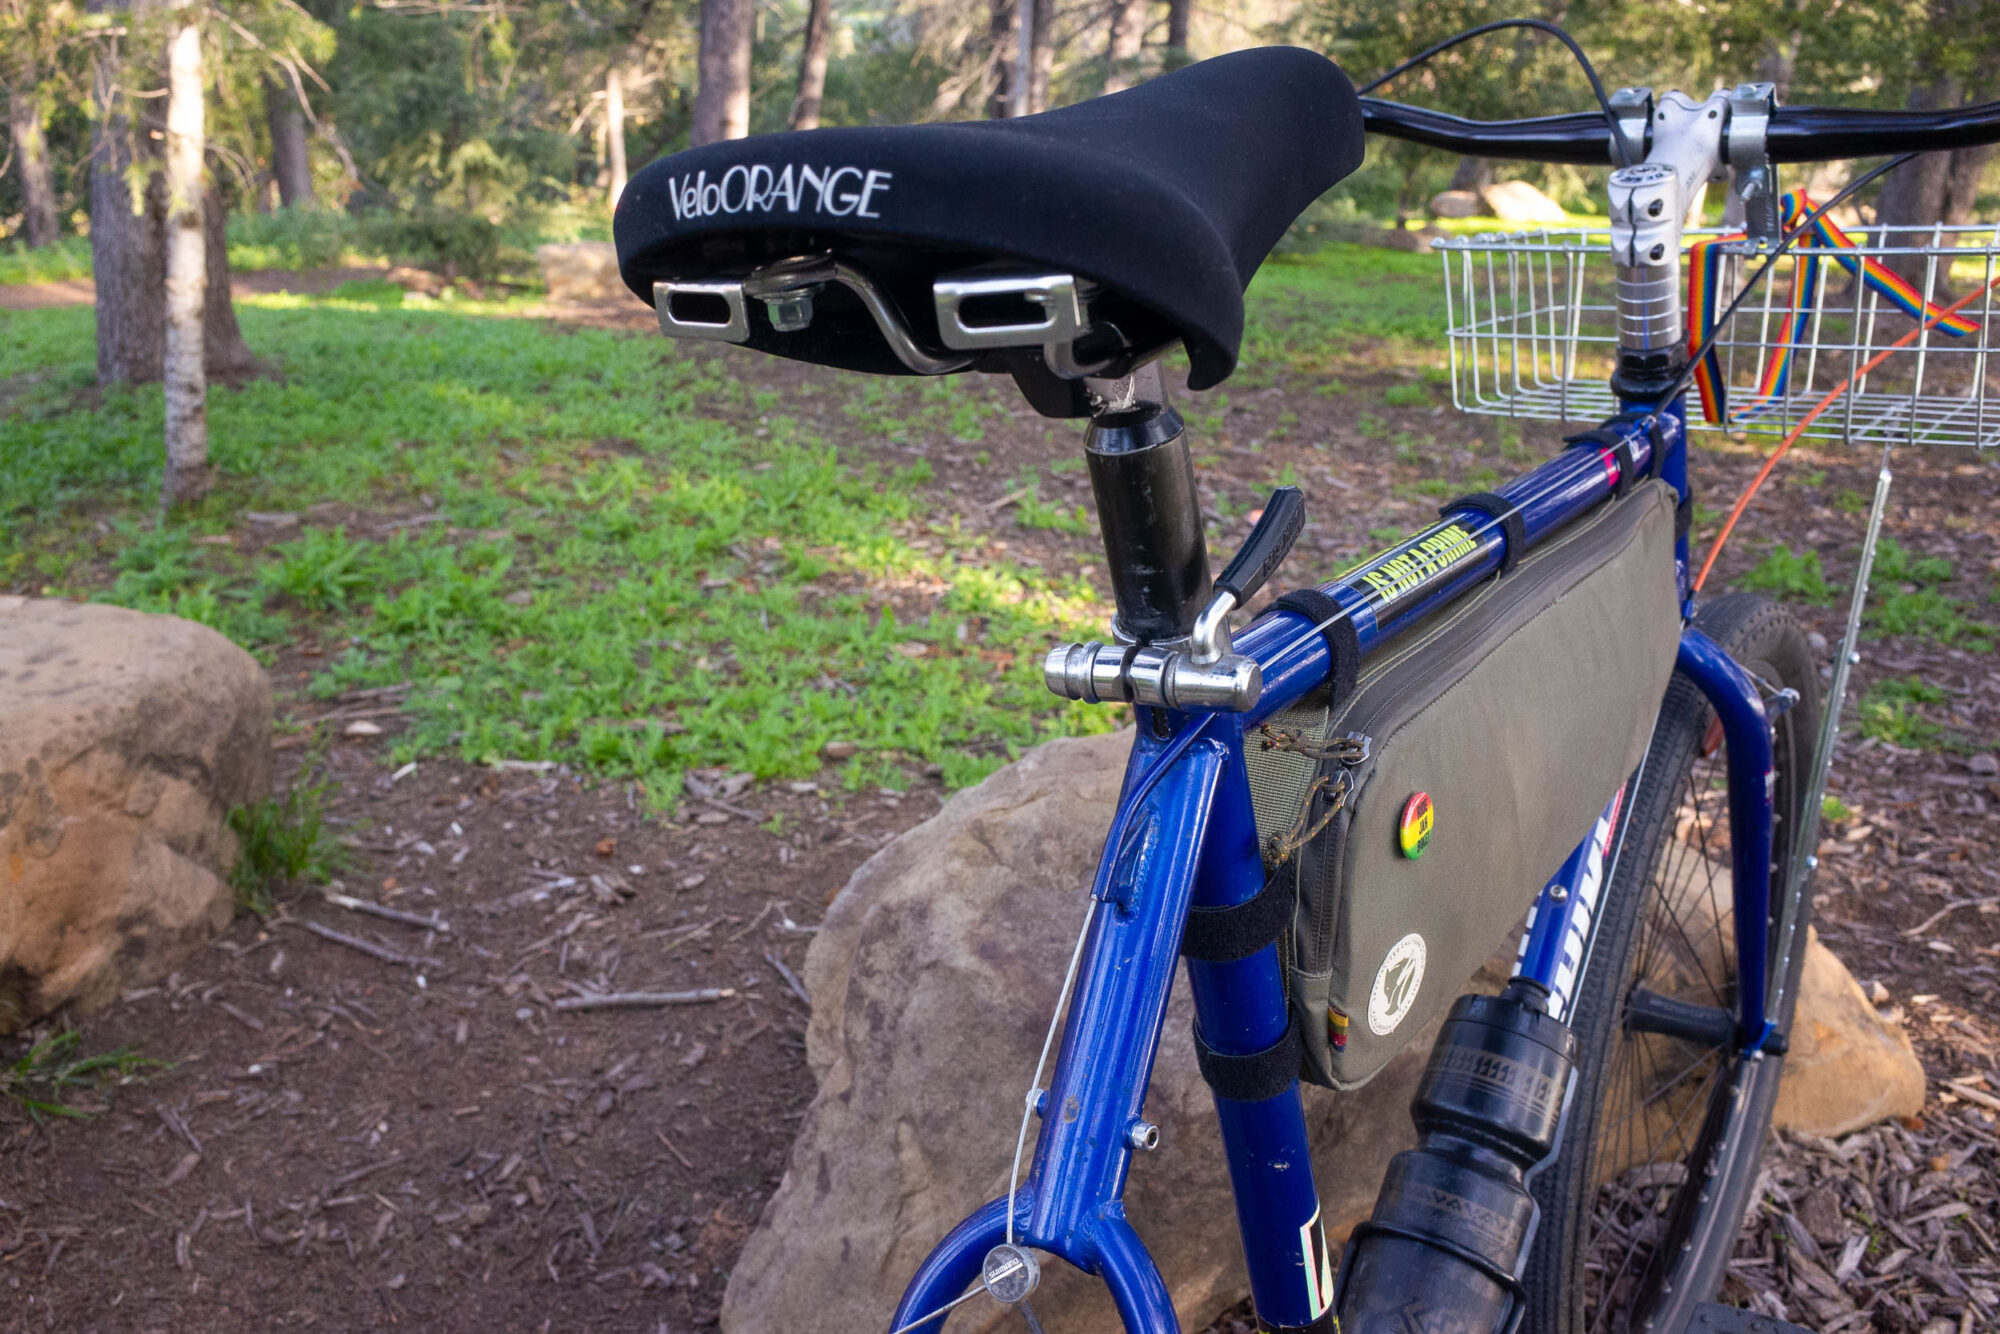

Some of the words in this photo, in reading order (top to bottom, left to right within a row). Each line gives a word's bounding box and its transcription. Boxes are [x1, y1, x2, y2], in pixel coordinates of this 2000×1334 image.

[1407, 548, 1439, 576] A
[1419, 524, 1478, 568] CRIME
[1360, 571, 1399, 603] IS
[1378, 553, 1426, 593] NOT
[988, 1257, 1019, 1279] SHIMANO
